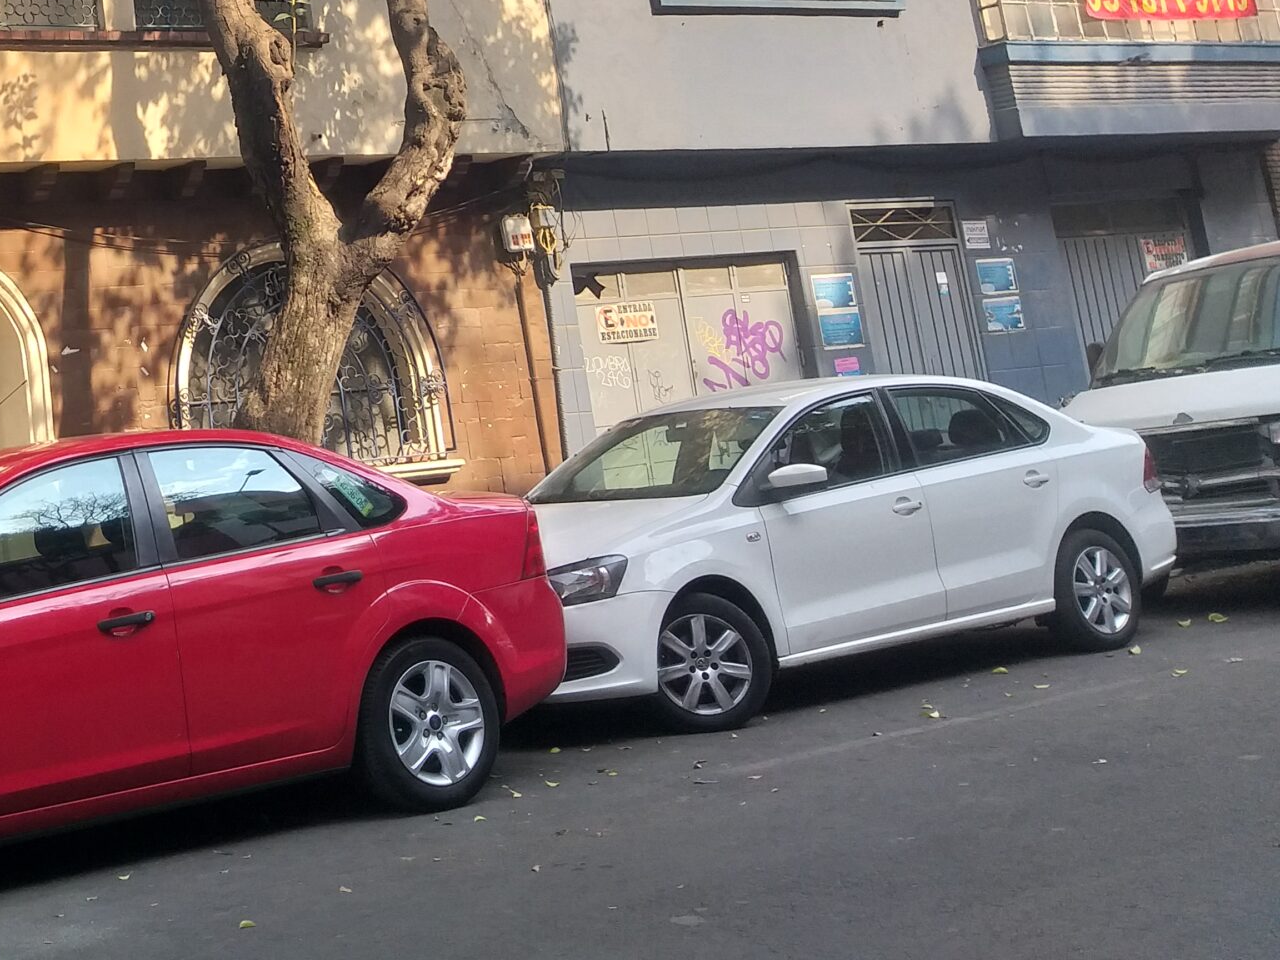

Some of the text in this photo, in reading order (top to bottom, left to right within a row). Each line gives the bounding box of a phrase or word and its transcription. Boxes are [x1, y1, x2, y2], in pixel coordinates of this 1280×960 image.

[616, 303, 652, 314] ENTRADA
[624, 314, 649, 328] NO
[600, 327, 658, 341] ESTACIONARSE
